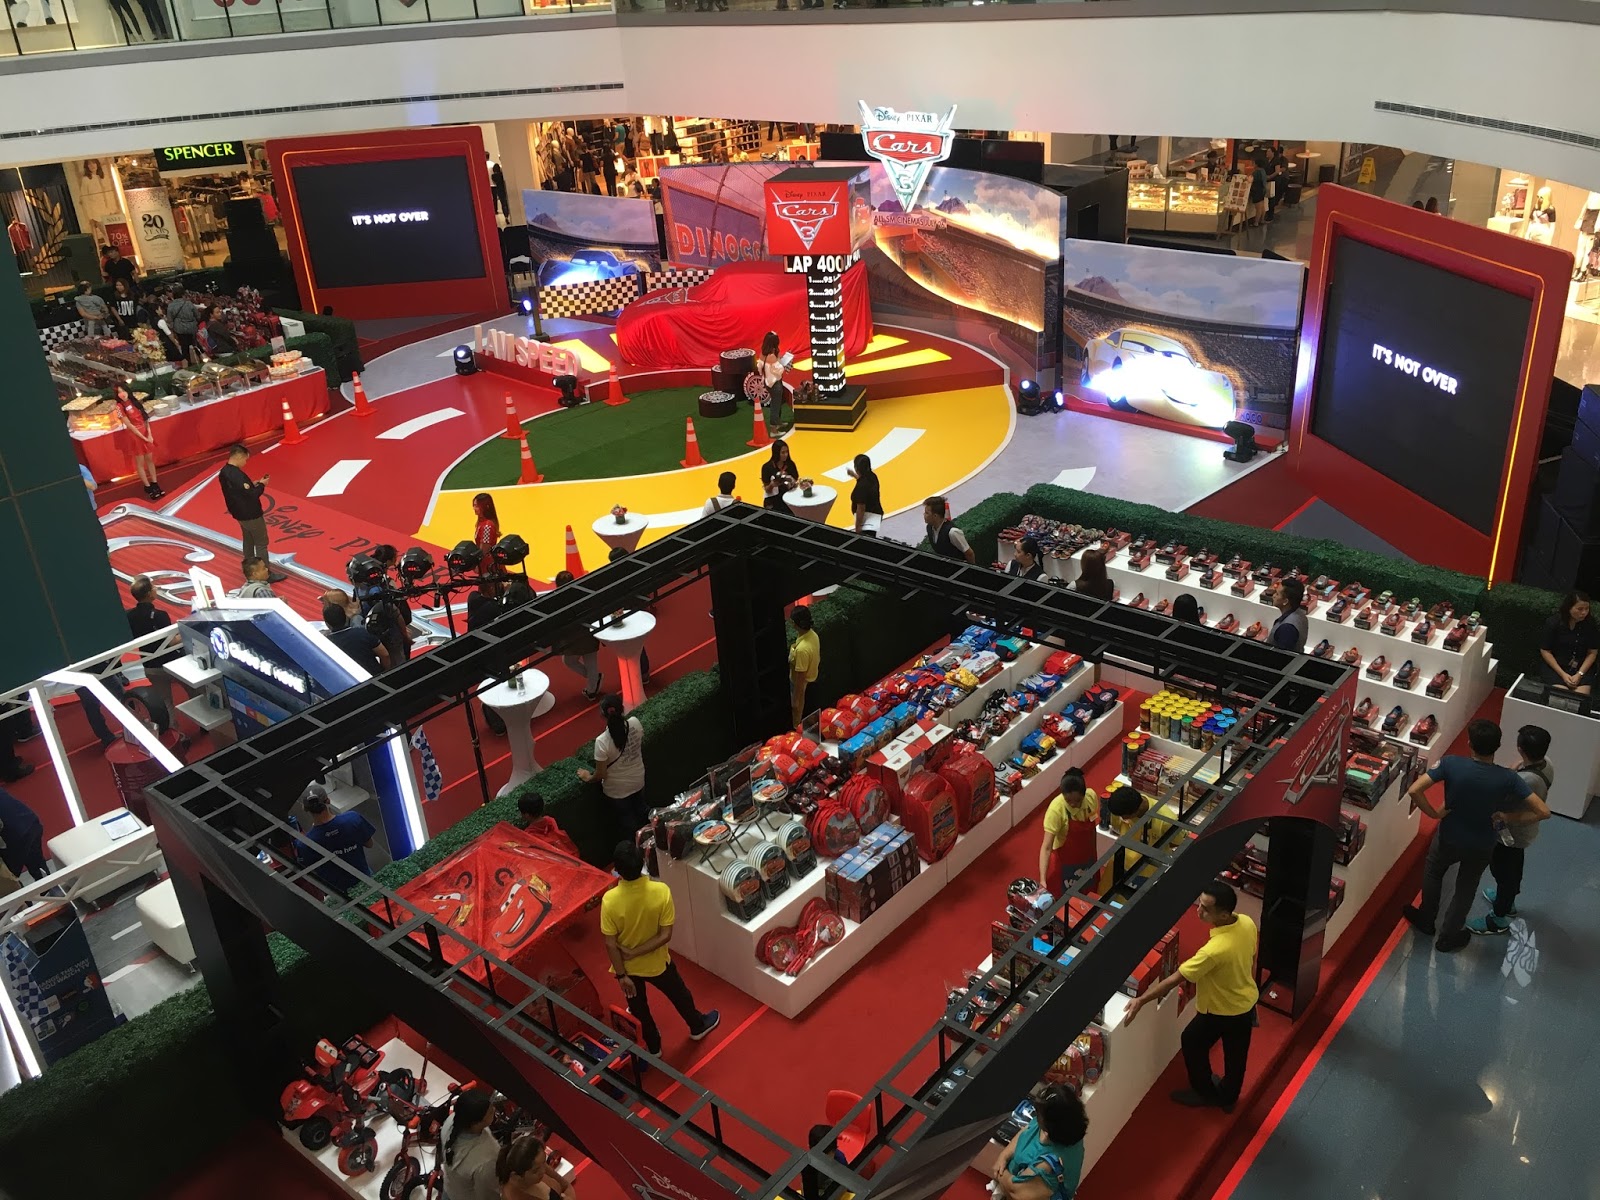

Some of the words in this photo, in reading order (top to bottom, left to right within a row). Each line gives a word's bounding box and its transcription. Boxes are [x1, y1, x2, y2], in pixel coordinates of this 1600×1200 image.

[874, 108, 901, 124] Disney
[906, 113, 933, 123] PIXAR
[163, 142, 236, 161] SPENCER
[872, 133, 935, 154] Cars
[785, 190, 803, 199] Disney
[351, 214, 372, 226] IT'S
[373, 212, 397, 225] NOT
[398, 210, 430, 223] OVER
[782, 204, 830, 216] Cars
[141, 213, 165, 229] 20
[897, 216, 924, 227] CINEMAS
[110, 232, 128, 241] 70%
[800, 225, 815, 241] 3
[111, 239, 130, 247] OFF
[784, 256, 813, 273] LAP
[816, 255, 844, 273] 400
[484, 328, 515, 362] AM
[515, 336, 582, 377] SPEED
[1372, 343, 1393, 365] IT'S
[1394, 353, 1421, 378] NOT
[1422, 366, 1458, 395] OVER
